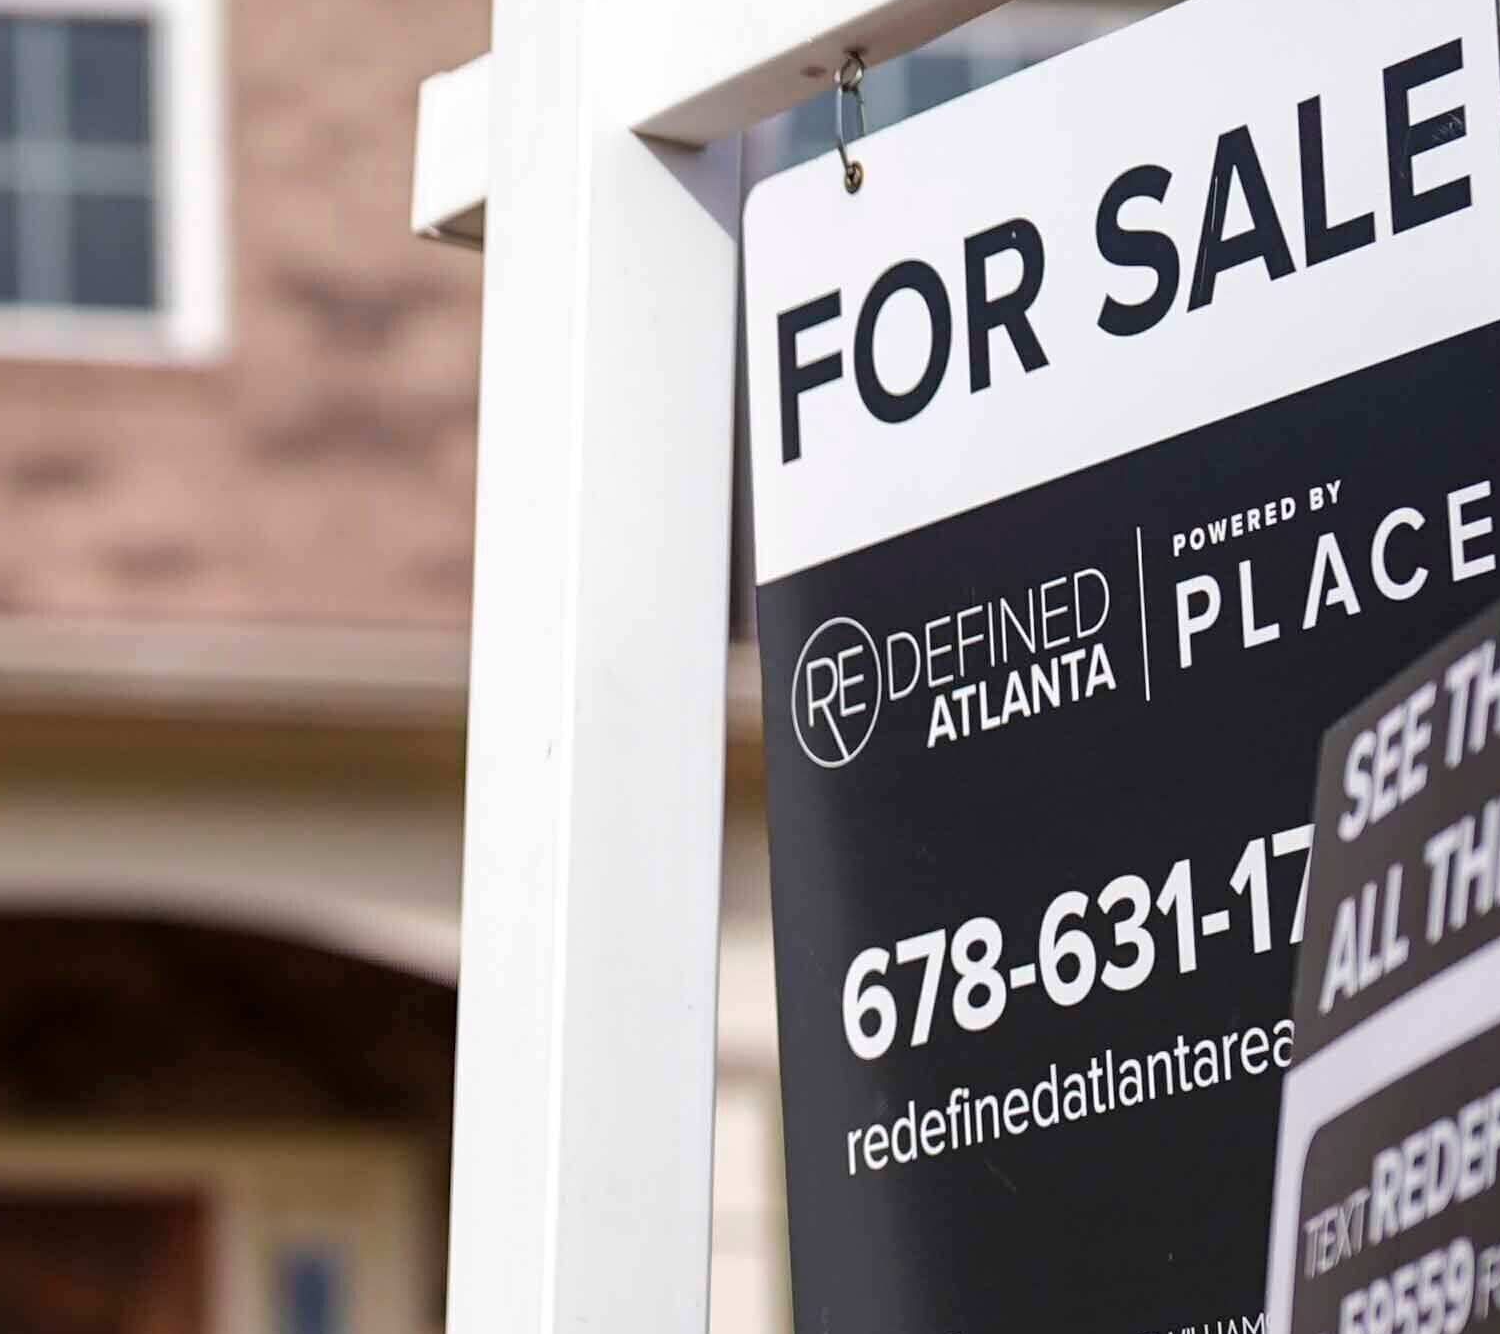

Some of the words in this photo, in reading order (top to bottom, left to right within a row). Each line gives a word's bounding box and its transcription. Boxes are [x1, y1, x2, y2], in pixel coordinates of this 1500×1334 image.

[776, 217, 1049, 464] FOR
[1095, 37, 1472, 337] SALE
[1172, 497, 1296, 558] POWERED
[1309, 479, 1343, 511] BY
[1175, 480, 1497, 669] PLACE
[926, 642, 1117, 749] ATLANTA
[1337, 680, 1437, 842] SEE
[842, 823, 1315, 1061] 678-631-17
[1318, 862, 1411, 1015] ALL
[846, 1018, 1296, 1177] redefinedatlantarea
[1304, 1186, 1370, 1280] TEXT
